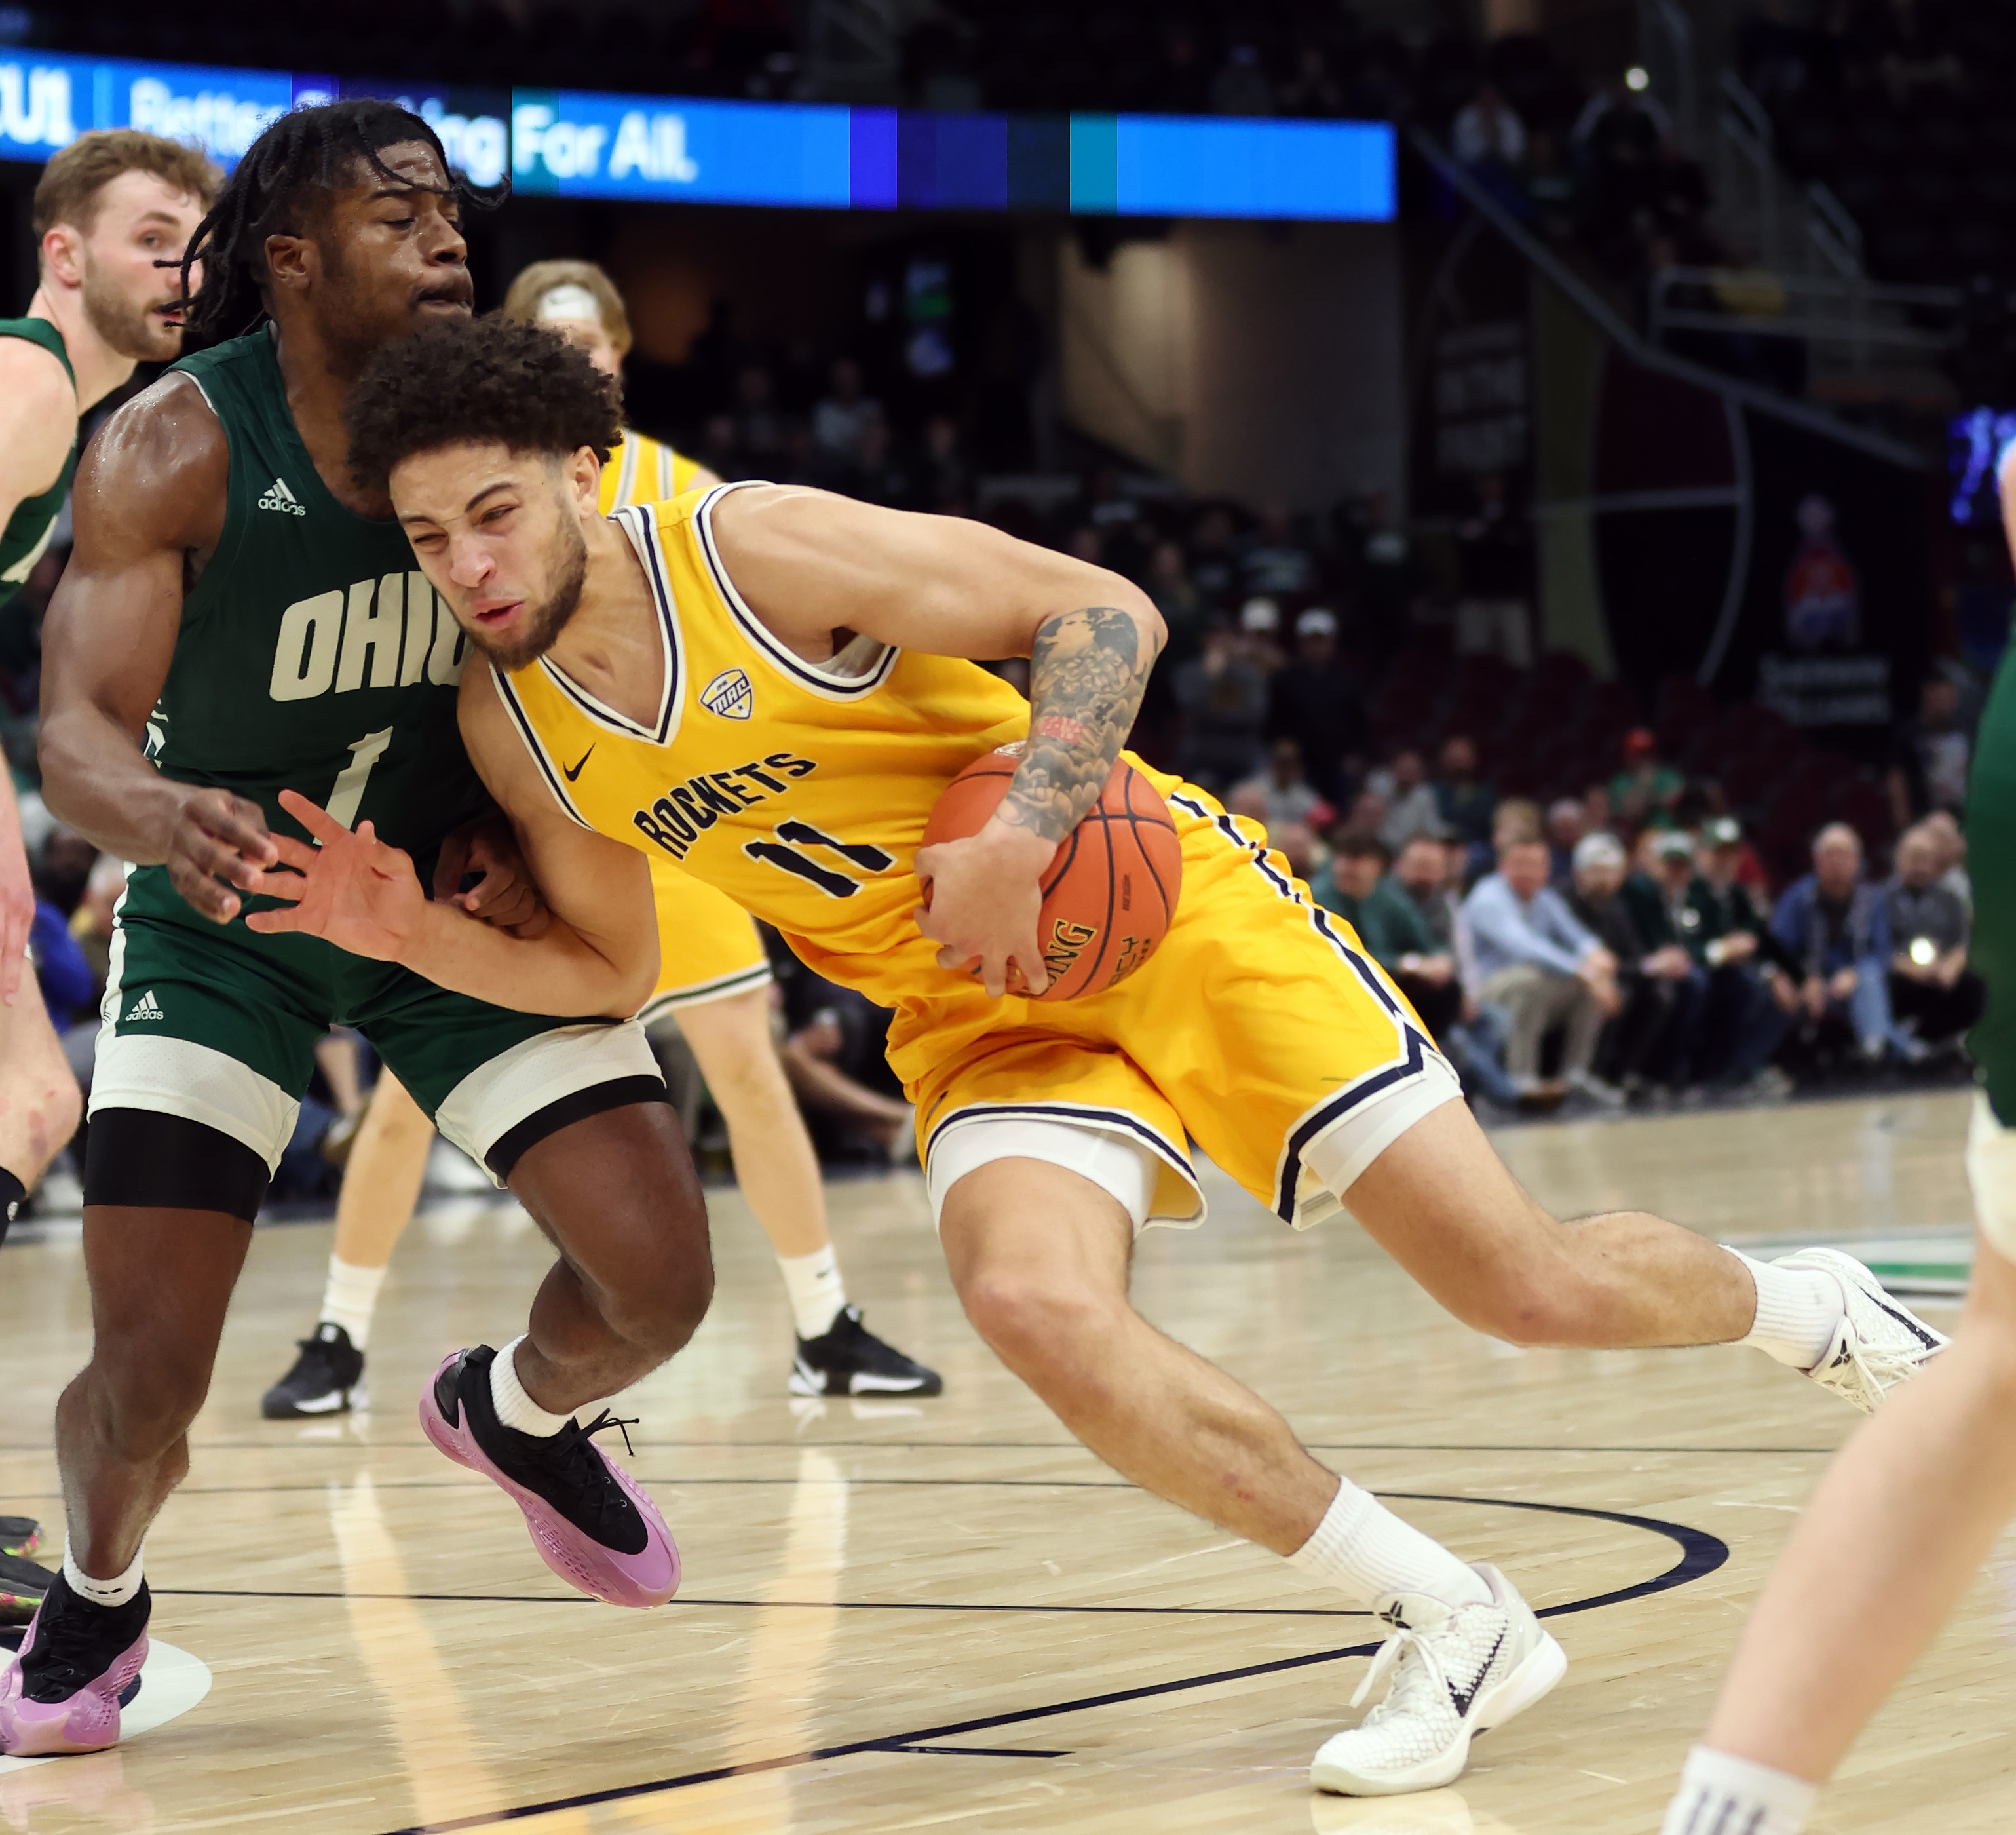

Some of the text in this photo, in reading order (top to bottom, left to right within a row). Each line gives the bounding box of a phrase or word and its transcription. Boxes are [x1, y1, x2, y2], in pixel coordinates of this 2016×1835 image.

[513, 104, 606, 178] For
[258, 497, 306, 516] adidas
[710, 678, 751, 716] MAC
[313, 725, 393, 845] 1
[633, 752, 816, 861] ROCKETS
[742, 817, 898, 900] 11
[125, 1009, 164, 1022] adidas
